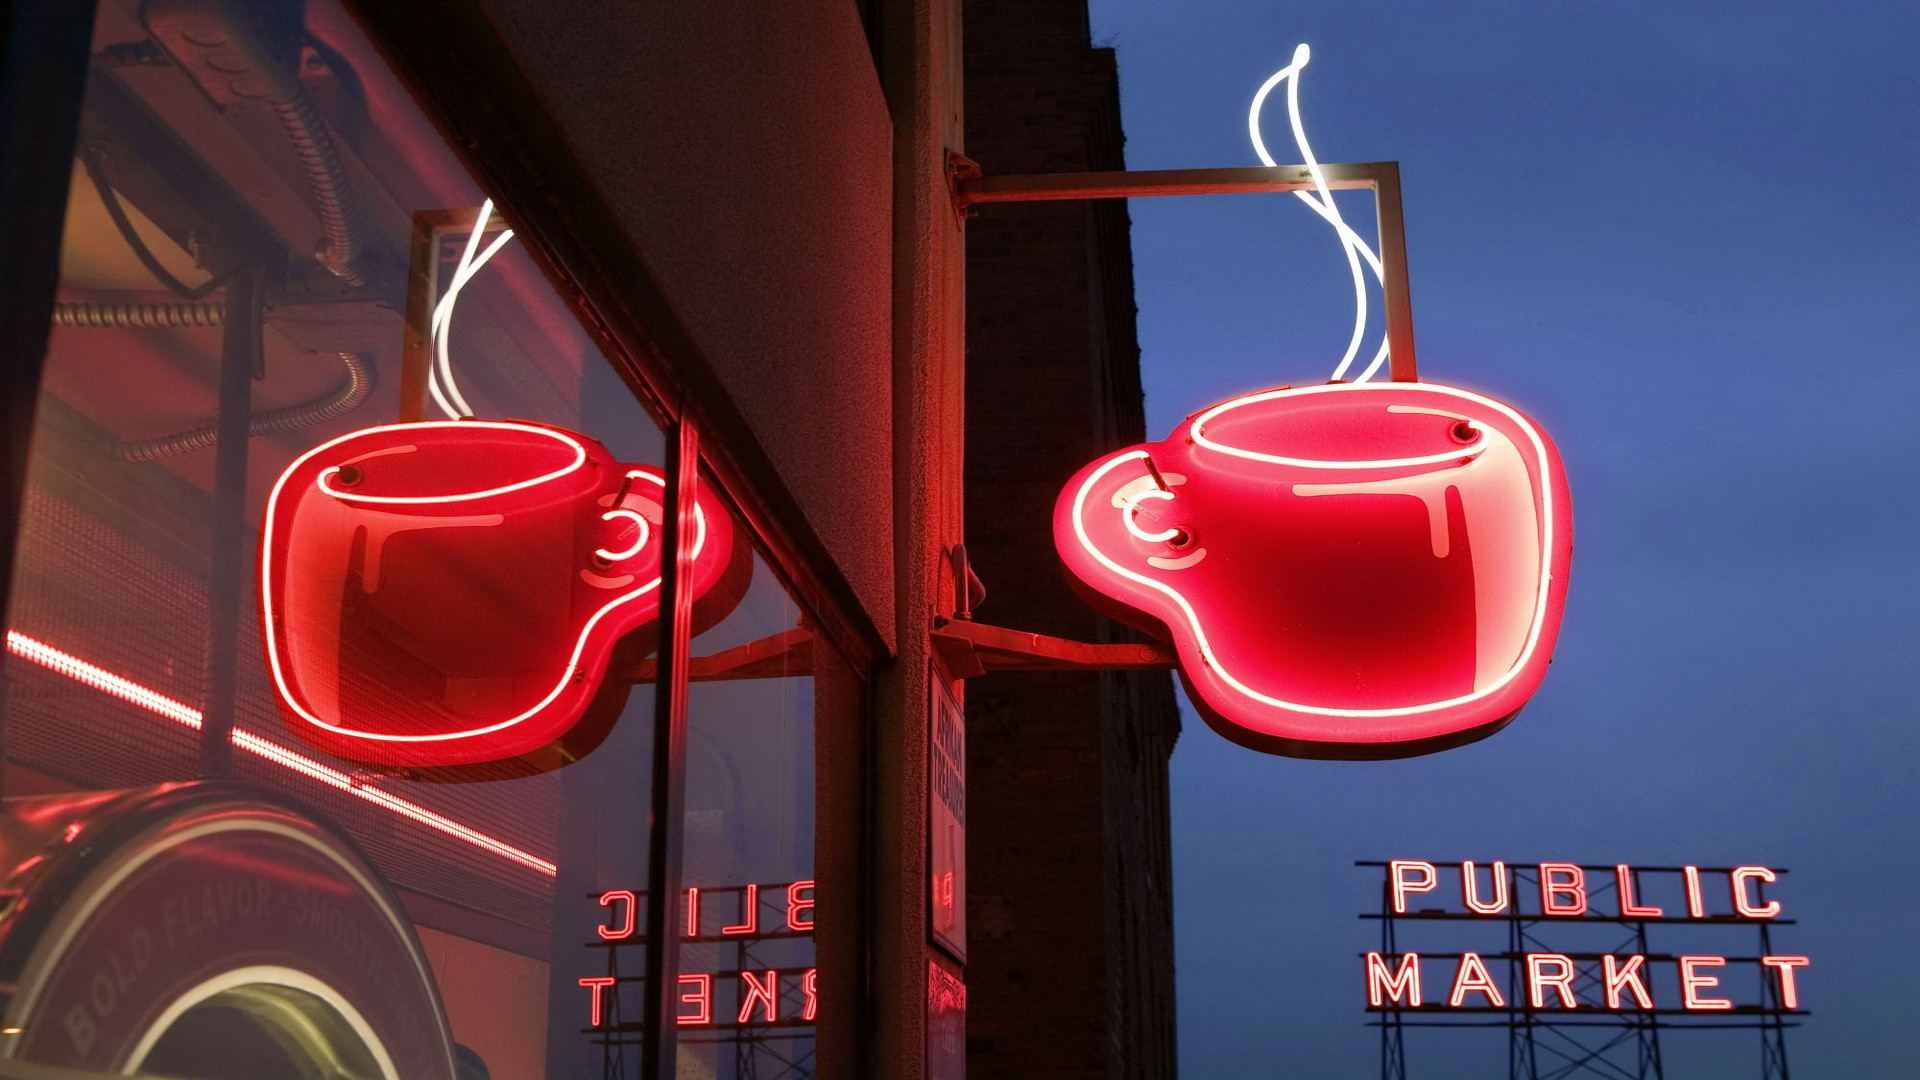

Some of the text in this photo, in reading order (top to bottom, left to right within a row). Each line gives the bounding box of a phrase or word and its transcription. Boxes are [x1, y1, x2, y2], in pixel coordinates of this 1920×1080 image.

[1389, 859, 1782, 919] PUBLIC
[63, 927, 154, 1058] BOLD
[161, 876, 270, 950] FLAVOR
[1365, 951, 1810, 1011] MARKET
